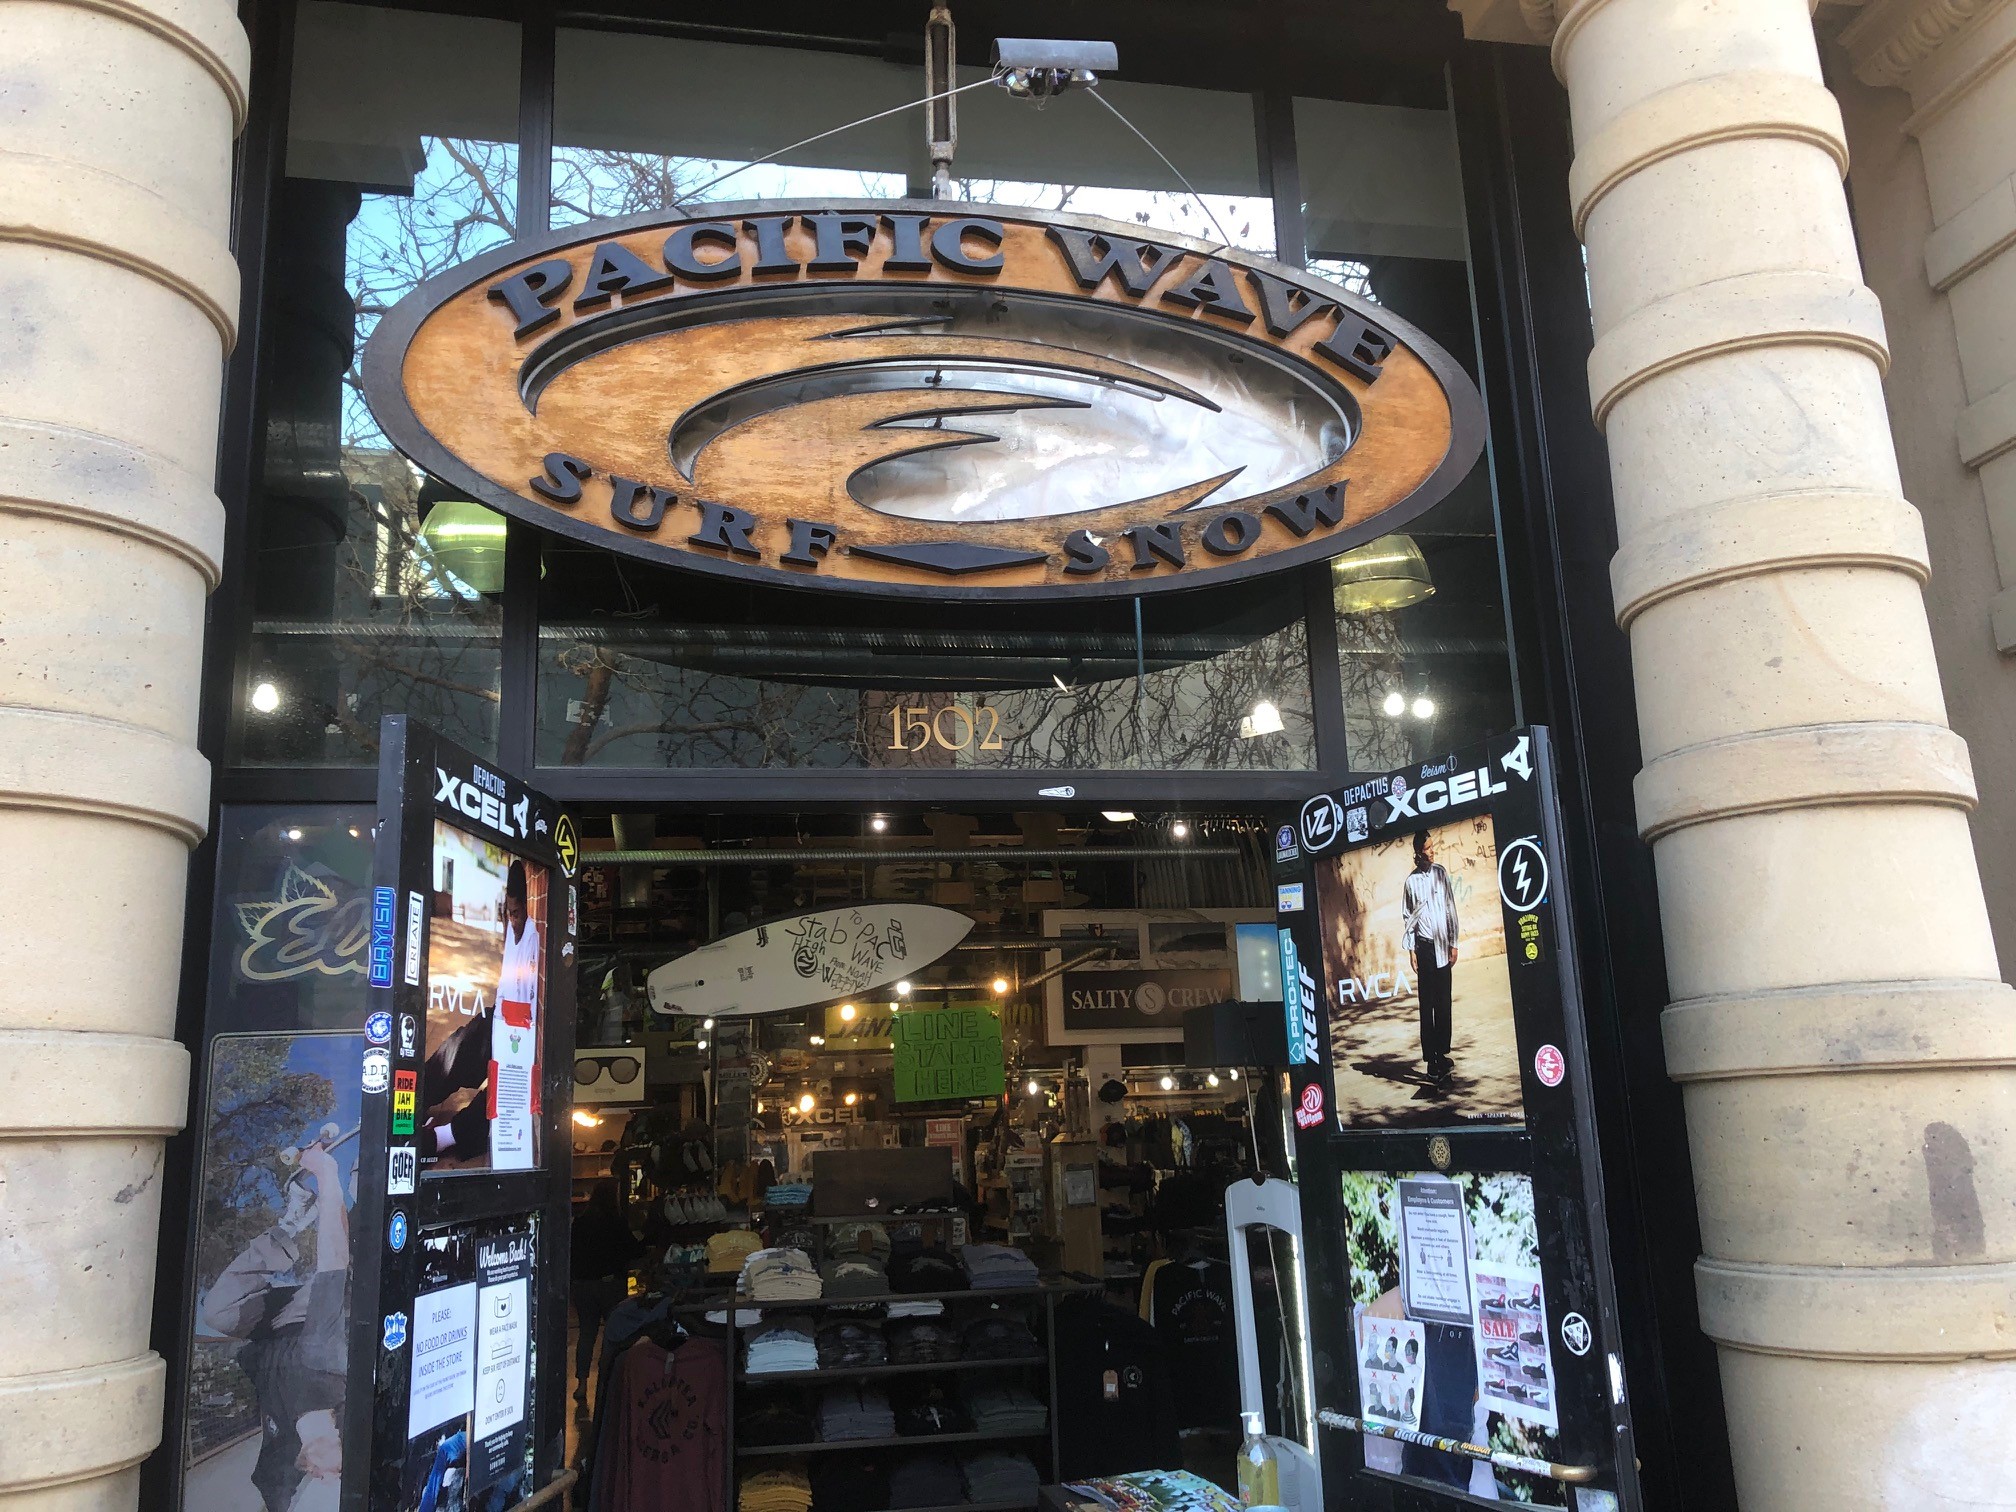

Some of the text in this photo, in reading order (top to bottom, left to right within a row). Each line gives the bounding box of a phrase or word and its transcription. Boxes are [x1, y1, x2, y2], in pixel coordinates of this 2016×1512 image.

[487, 213, 1398, 387] PACIFIC WAVE
[529, 451, 1351, 576] SURF SNOW
[887, 703, 1003, 752] 1502
[473, 764, 506, 799] DEPACTUS
[1343, 776, 1389, 807] DEPACTUS
[1384, 766, 1508, 824] XCEL
[434, 767, 515, 838] XCEL
[372, 889, 391, 980] BAYISM
[408, 907, 420, 975] CREATE
[784, 916, 848, 945] Stab
[851, 942, 885, 974] WAVE
[429, 980, 487, 1018] RVCA
[1071, 989, 1133, 1011] SALTY
[1168, 987, 1224, 1005] CREW
[1338, 970, 1413, 1006] RVCA
[901, 1011, 980, 1042] LINE
[1297, 960, 1320, 1065] REEF
[897, 1036, 1004, 1068] STARTS
[396, 1077, 414, 1091] RIDE
[915, 1067, 987, 1097] HERE
[395, 1108, 412, 1121] BIKE
[397, 1092, 411, 1106] JAH
[391, 1152, 414, 1187] GOER
[479, 1242, 508, 1269] Welcome
[431, 1308, 452, 1324] PLEASE:
[1171, 1288, 1229, 1316] PACIFIC WAVE
[416, 1341, 425, 1355] NO
[424, 1335, 440, 1351] FOOD
[440, 1332, 448, 1346] OR
[448, 1326, 468, 1342] DRINKS
[1484, 1320, 1516, 1339] SALE
[418, 1350, 463, 1378] INSIDE THE STORE
